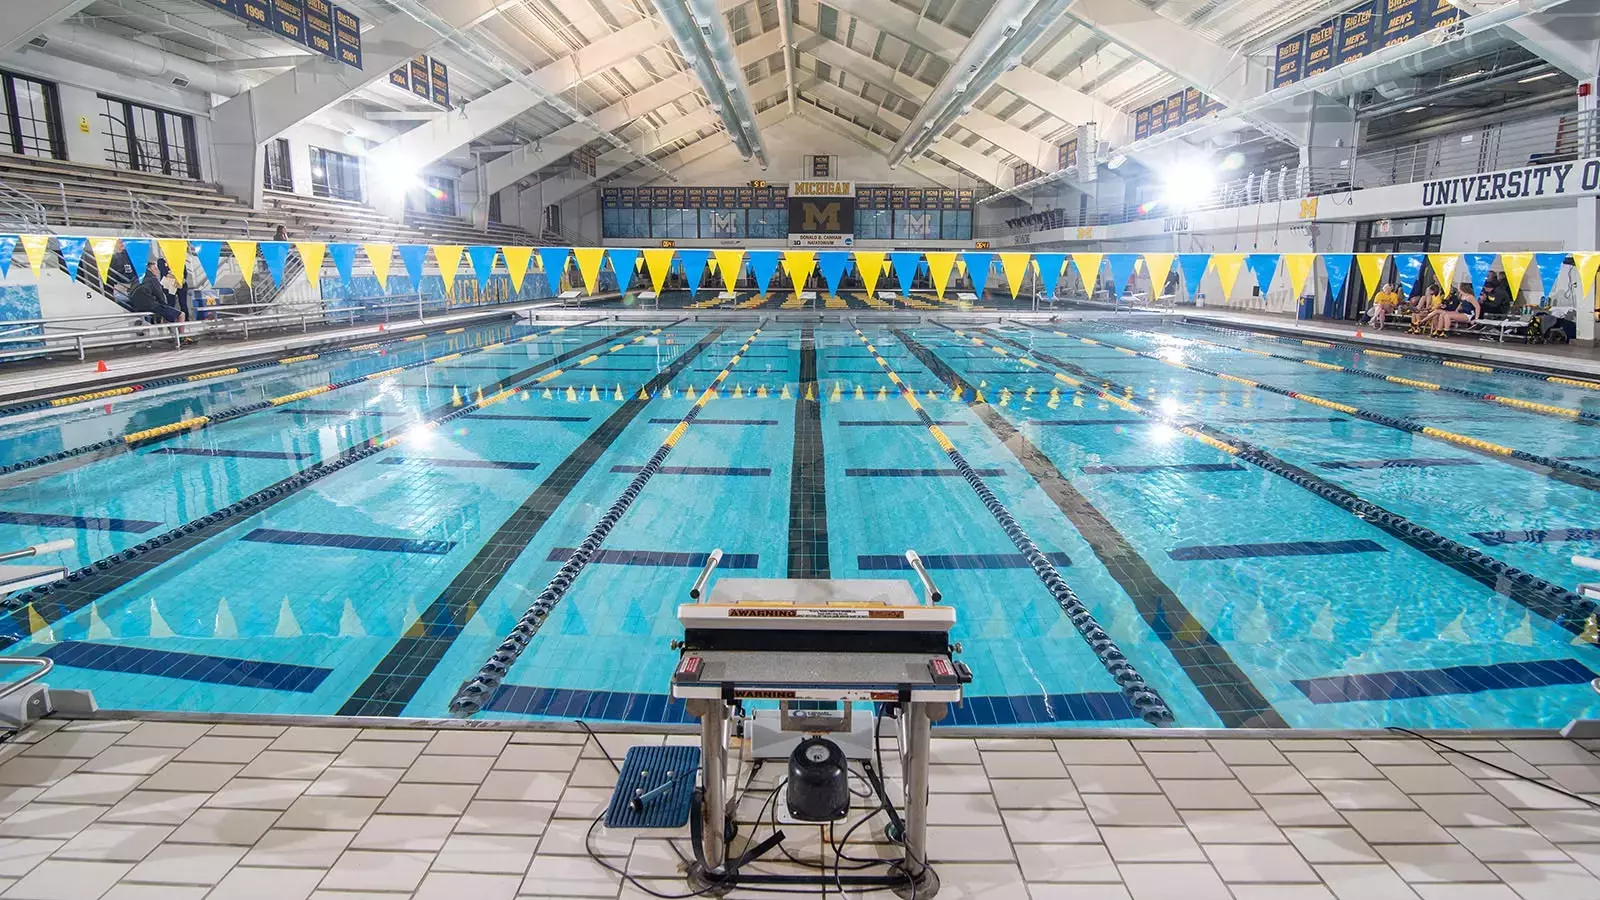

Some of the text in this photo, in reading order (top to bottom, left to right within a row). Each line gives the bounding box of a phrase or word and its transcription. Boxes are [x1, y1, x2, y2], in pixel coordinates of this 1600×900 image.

[795, 181, 850, 196] MICHIGAN
[1423, 160, 1600, 206] UNIVERSITY O
[802, 202, 841, 231] M
[1300, 197, 1318, 218] M
[709, 213, 736, 233] M
[903, 214, 932, 235] M
[1163, 215, 1189, 233] DIVING
[735, 608, 797, 618] WARNING
[735, 691, 796, 699] WARNING
